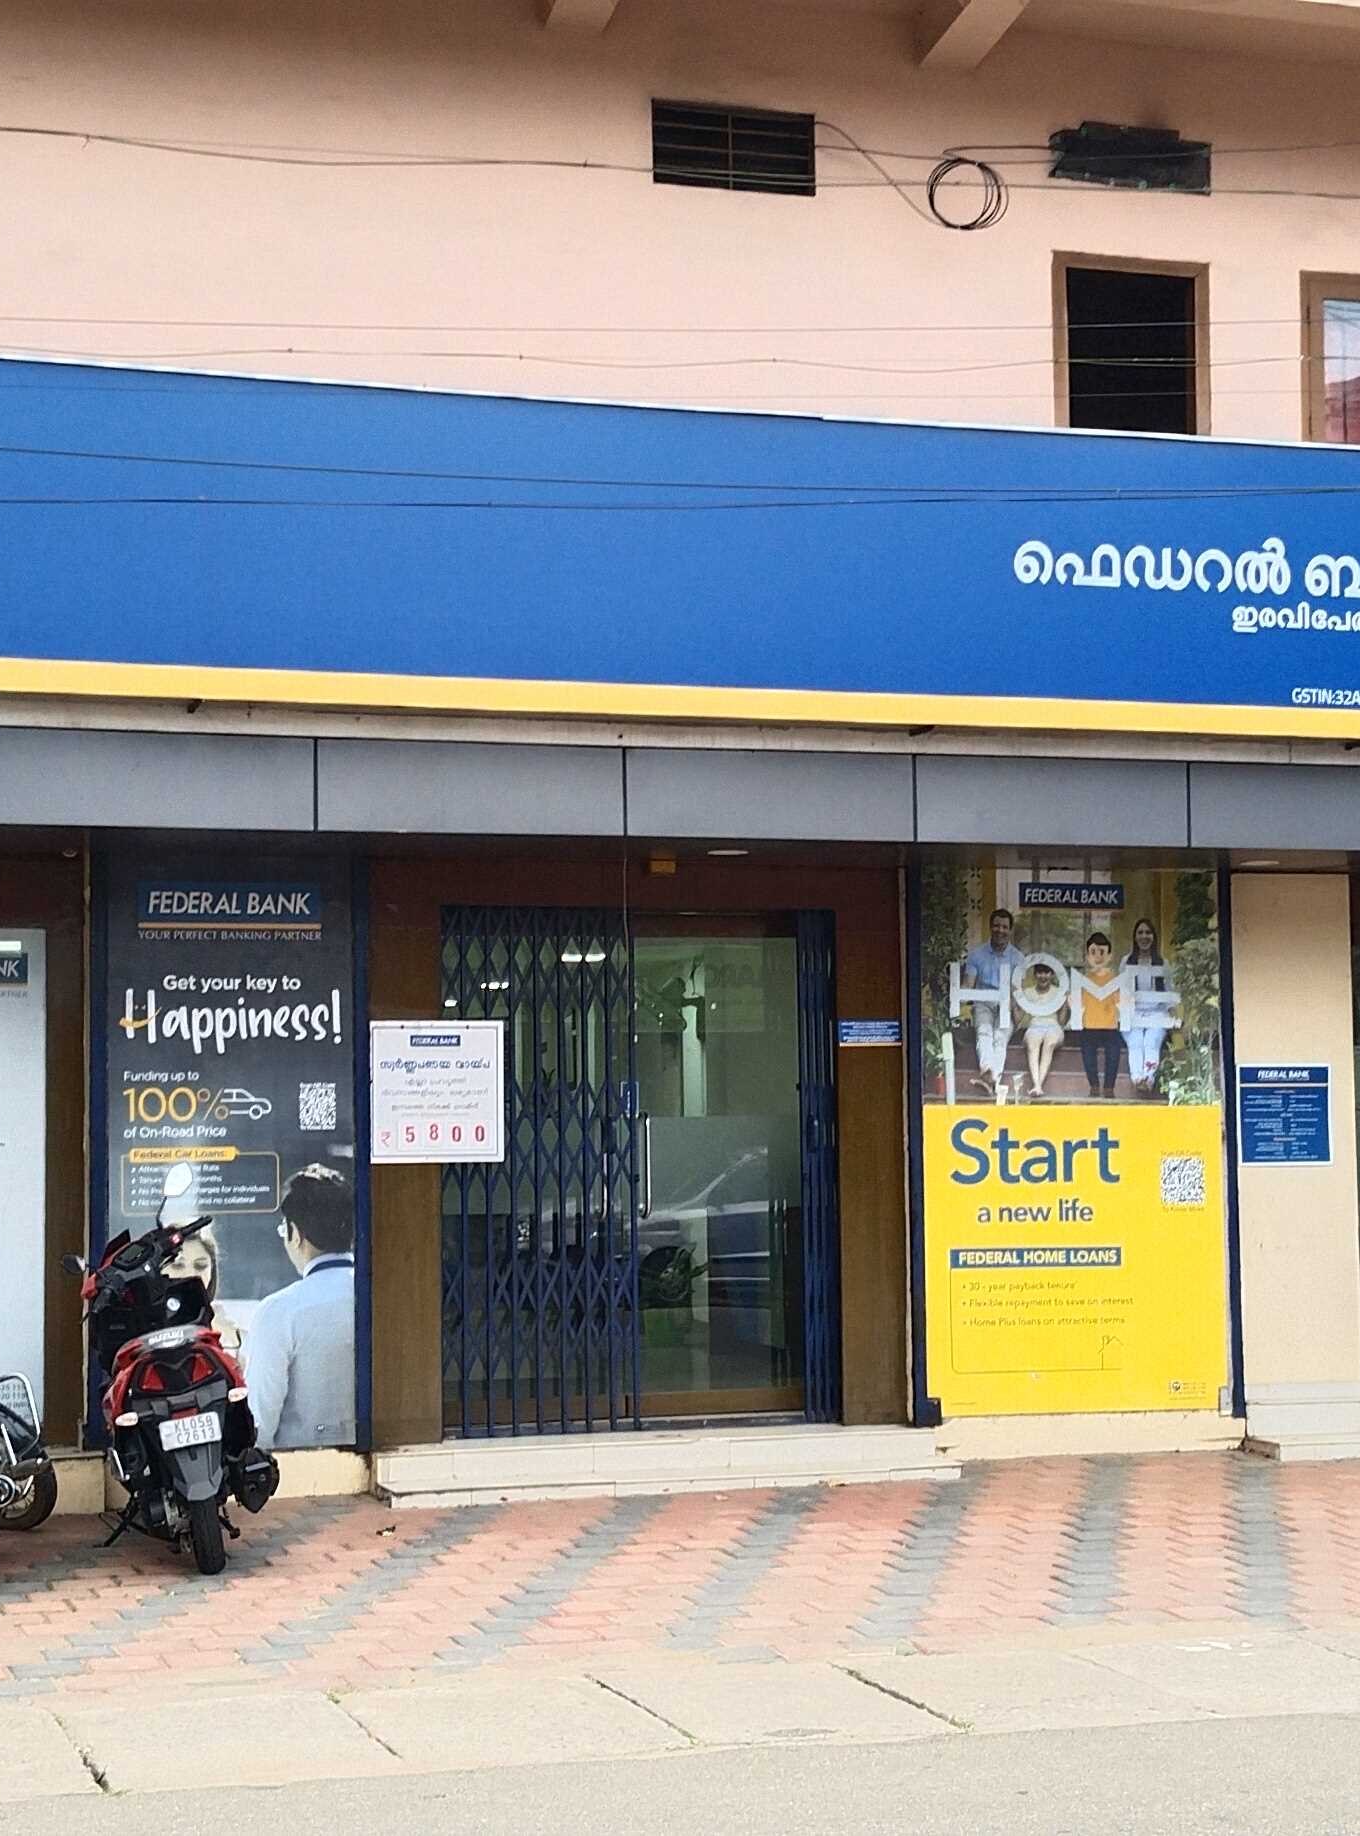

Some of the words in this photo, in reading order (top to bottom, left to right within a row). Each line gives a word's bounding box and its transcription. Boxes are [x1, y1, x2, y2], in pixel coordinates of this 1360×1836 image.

[1013, 536, 1292, 596] ഫെഡറൽ
[148, 890, 241, 916] FEDERAL
[246, 892, 311, 916] BANK
[1025, 888, 1078, 903] FEDERAL
[1081, 890, 1119, 904] BANK
[138, 930, 170, 940] YOUR
[173, 930, 218, 941] PERFECT
[220, 930, 272, 941] BANKING
[274, 930, 322, 941] PARTNER
[163, 975, 196, 991] Get
[201, 978, 240, 993] your
[246, 974, 278, 994] key
[282, 976, 301, 991] to
[949, 953, 1183, 1032] HOME
[121, 988, 342, 1055] Happiness!
[123, 1071, 169, 1082] Funding
[171, 1073, 185, 1082] up
[187, 1071, 199, 1081] to
[122, 1086, 230, 1123] 100%
[123, 1126, 136, 1138] of
[139, 1126, 194, 1138] On-Road
[196, 1126, 227, 1137] Price
[950, 1118, 1121, 1185] Start
[977, 1205, 991, 1222] a
[998, 1203, 1052, 1222] new
[1058, 1198, 1094, 1222] life
[959, 1251, 1021, 1265] FEDERAL
[1023, 1250, 1067, 1264] HOME
[1069, 1250, 1118, 1263] LOANS
